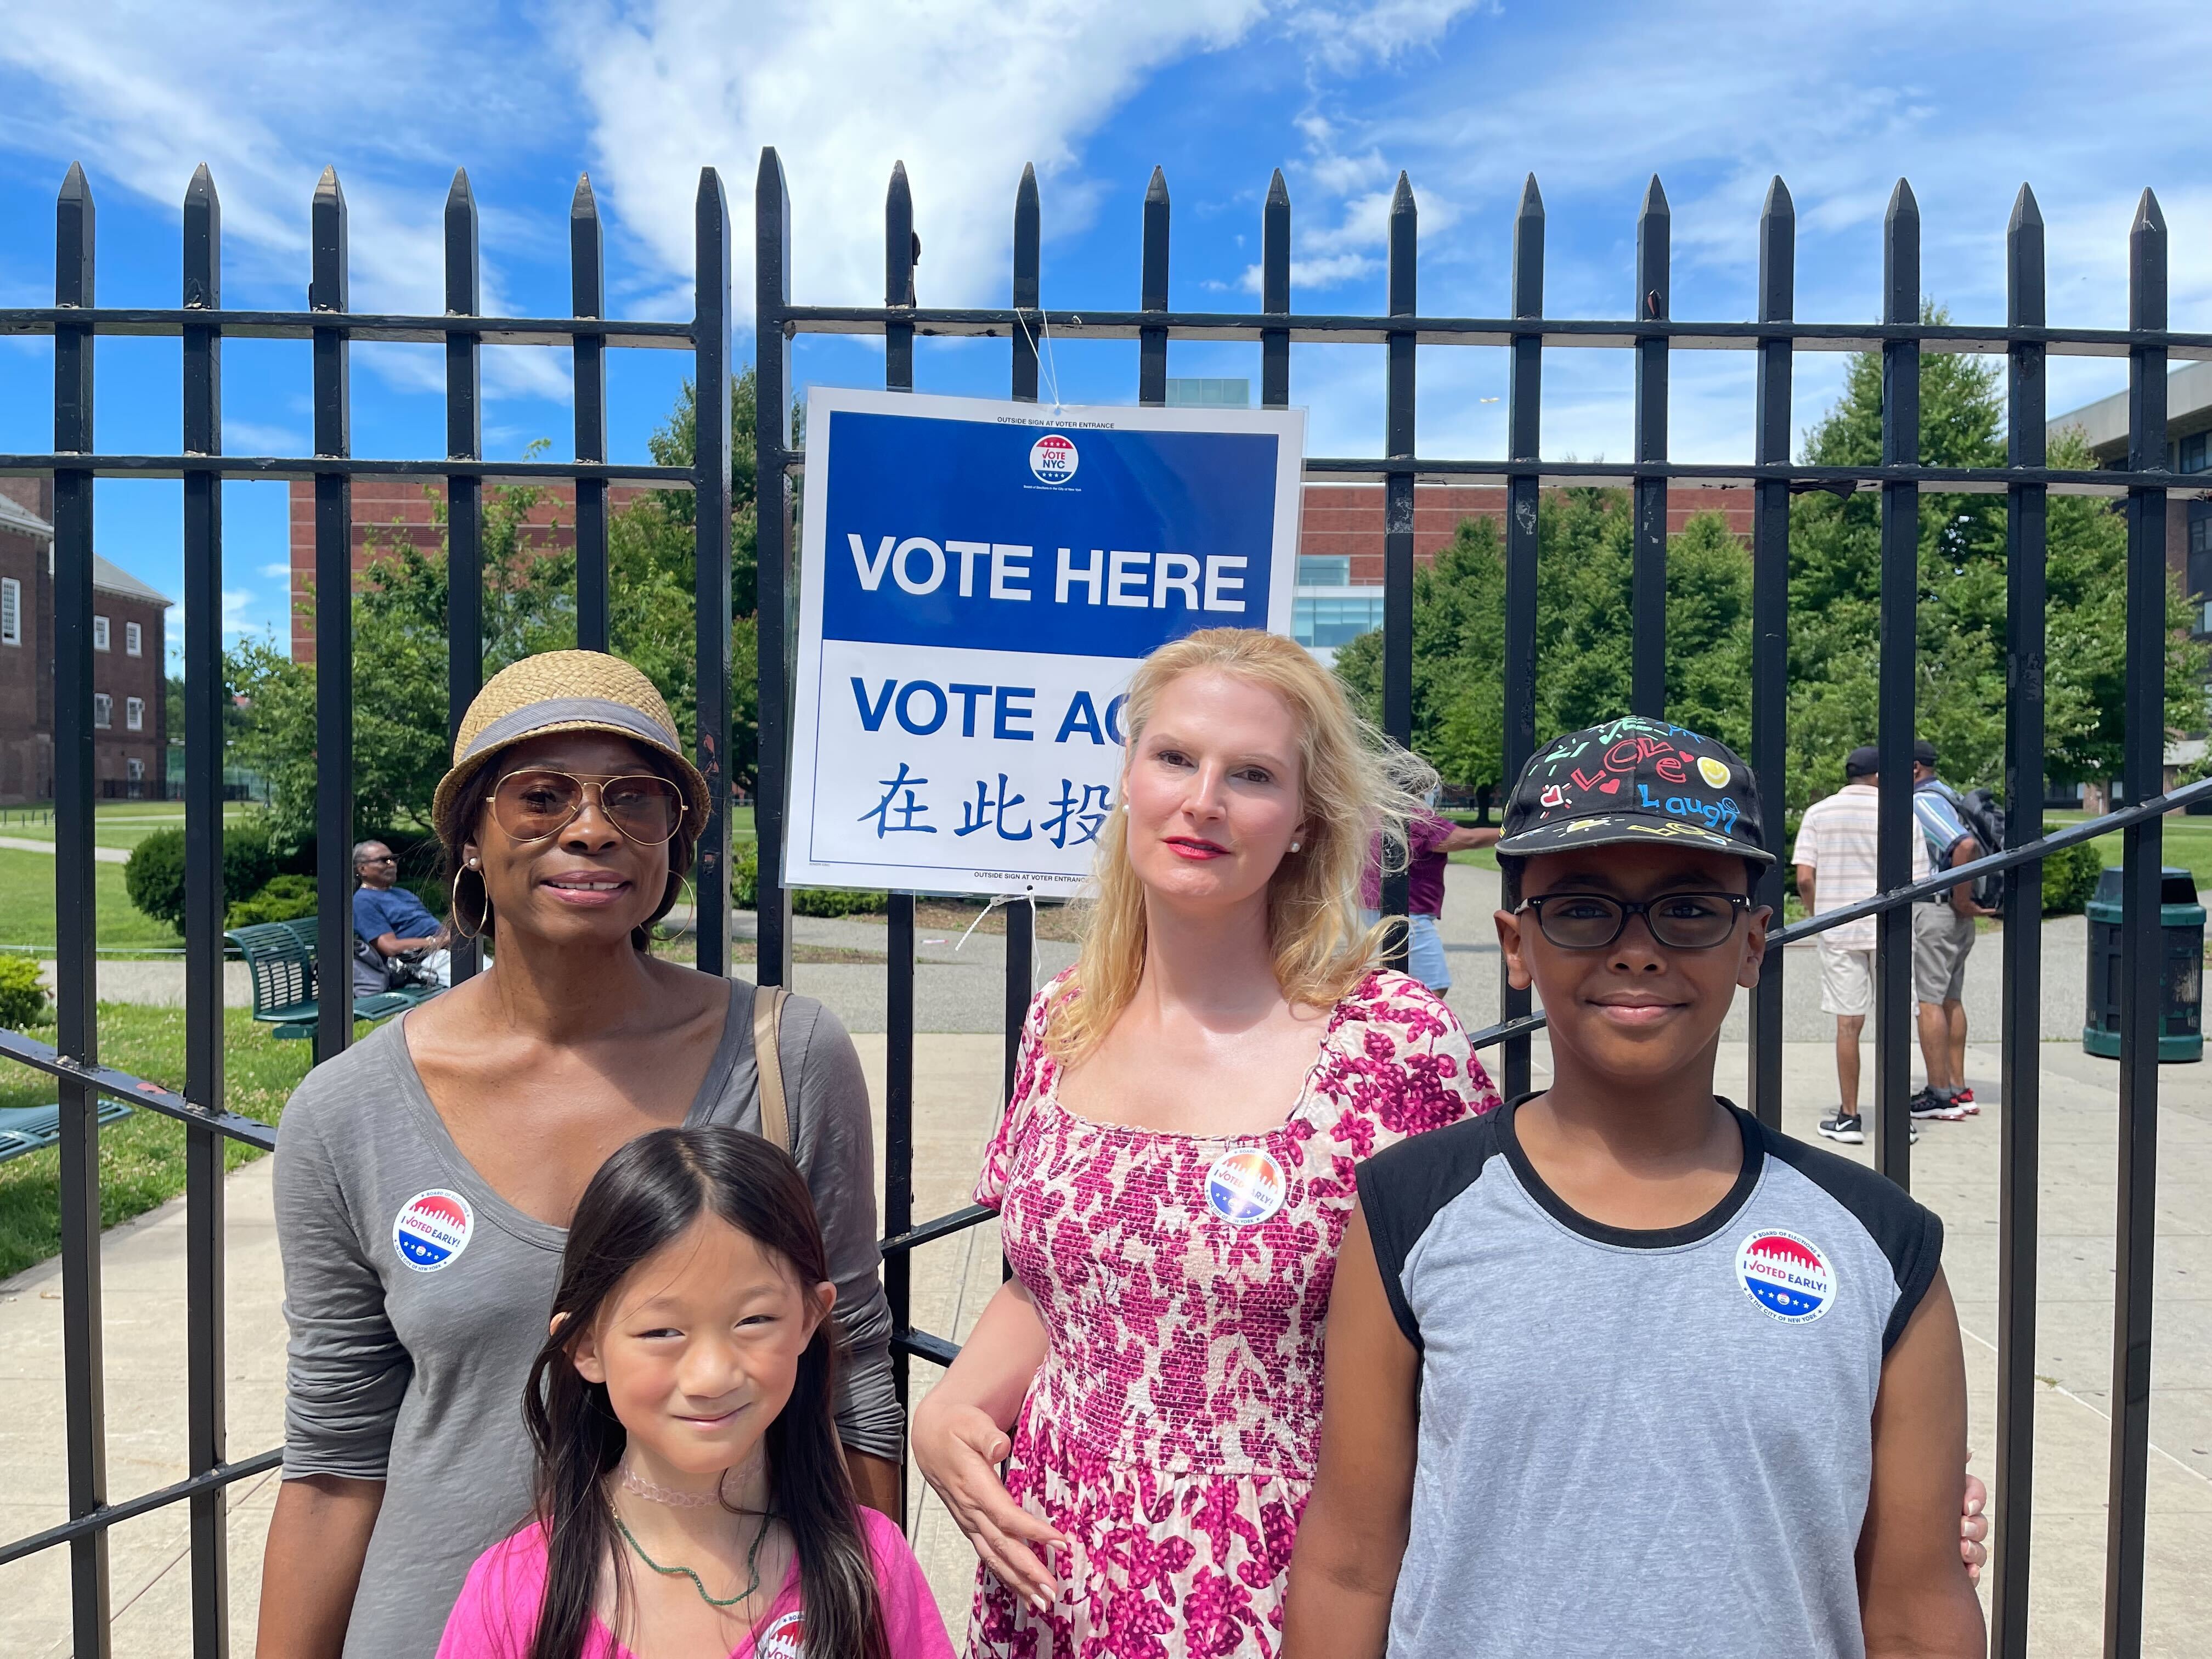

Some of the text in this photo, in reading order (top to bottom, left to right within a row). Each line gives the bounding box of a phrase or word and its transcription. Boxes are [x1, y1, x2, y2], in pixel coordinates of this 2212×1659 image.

[1042, 449, 1065, 460] VOTE
[1043, 460, 1065, 469] NYC
[847, 533, 1248, 612] VOTE HERE
[850, 676, 1036, 741] VOTE
[856, 762, 1115, 849] 在此投
[1637, 784, 1741, 834] Laugh
[406, 1216, 432, 1233] VOTED
[431, 1229, 461, 1248] EARLY!
[1788, 1234, 1817, 1254] ELECTIONS
[403, 1257, 411, 1266] CITY
[1743, 1260, 1827, 1293] I VOTED EARLY!
[1753, 1300, 1762, 1310] THE
[1763, 1308, 1777, 1318] CITY
[1802, 1312, 1818, 1322] YORK
